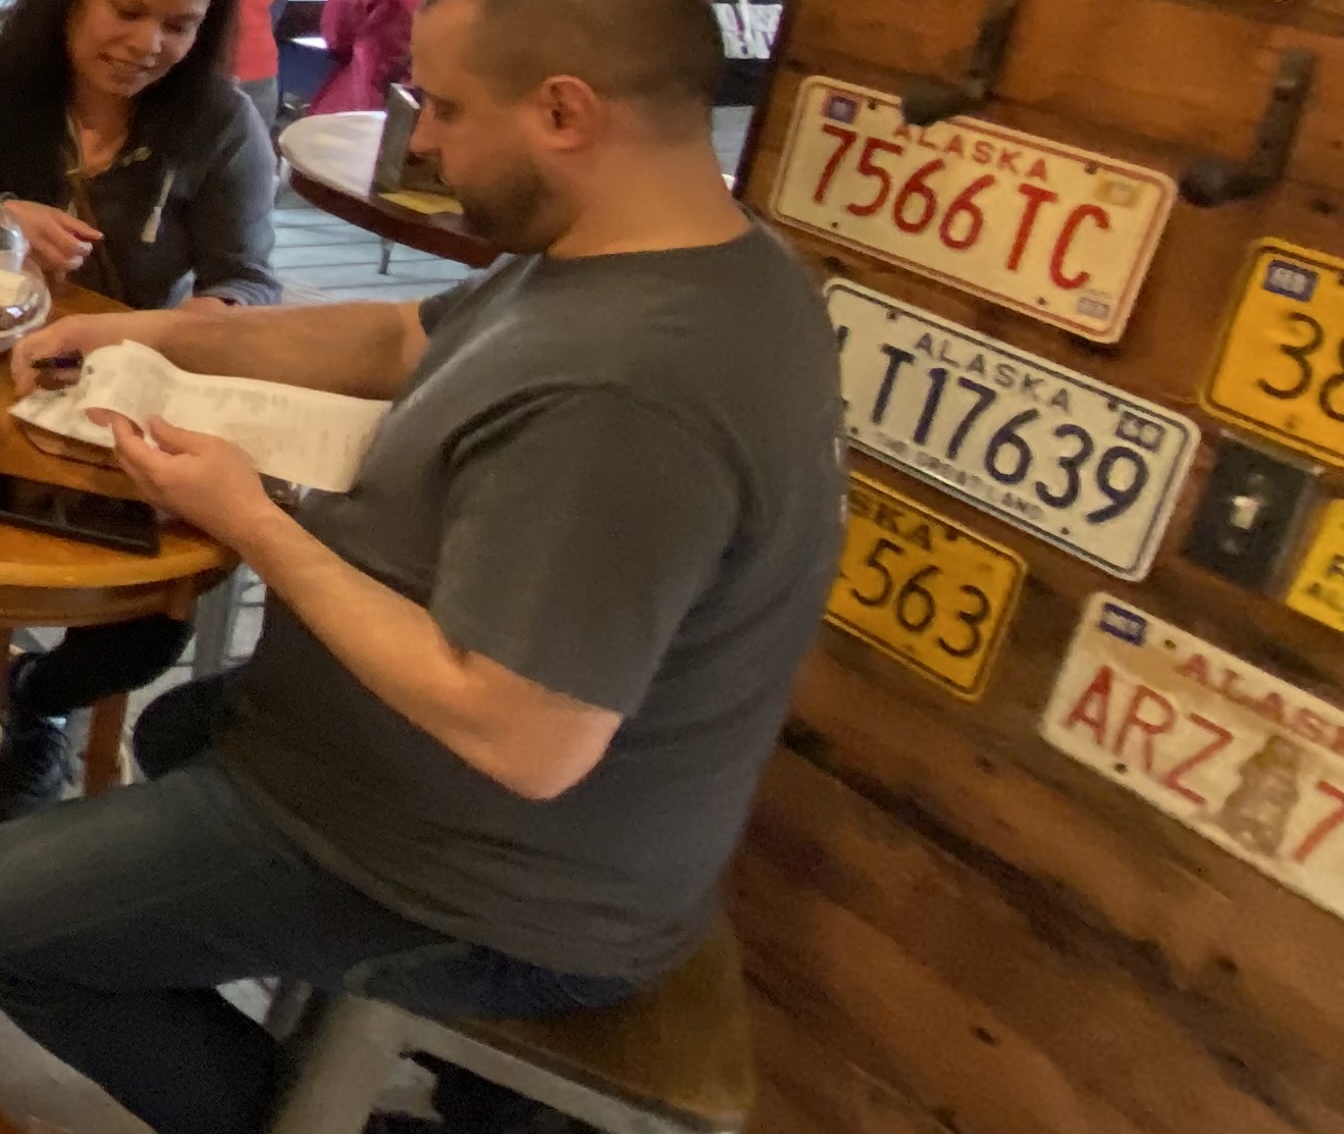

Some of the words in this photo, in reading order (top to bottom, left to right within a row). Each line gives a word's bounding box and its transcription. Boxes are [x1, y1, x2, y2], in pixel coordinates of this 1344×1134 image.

[813, 123, 1111, 290] 7566TC
[891, 123, 1050, 184] ALASKA
[913, 331, 1073, 413] ALASKA
[839, 537, 992, 659] 563
[1064, 665, 1234, 807] ARZ
